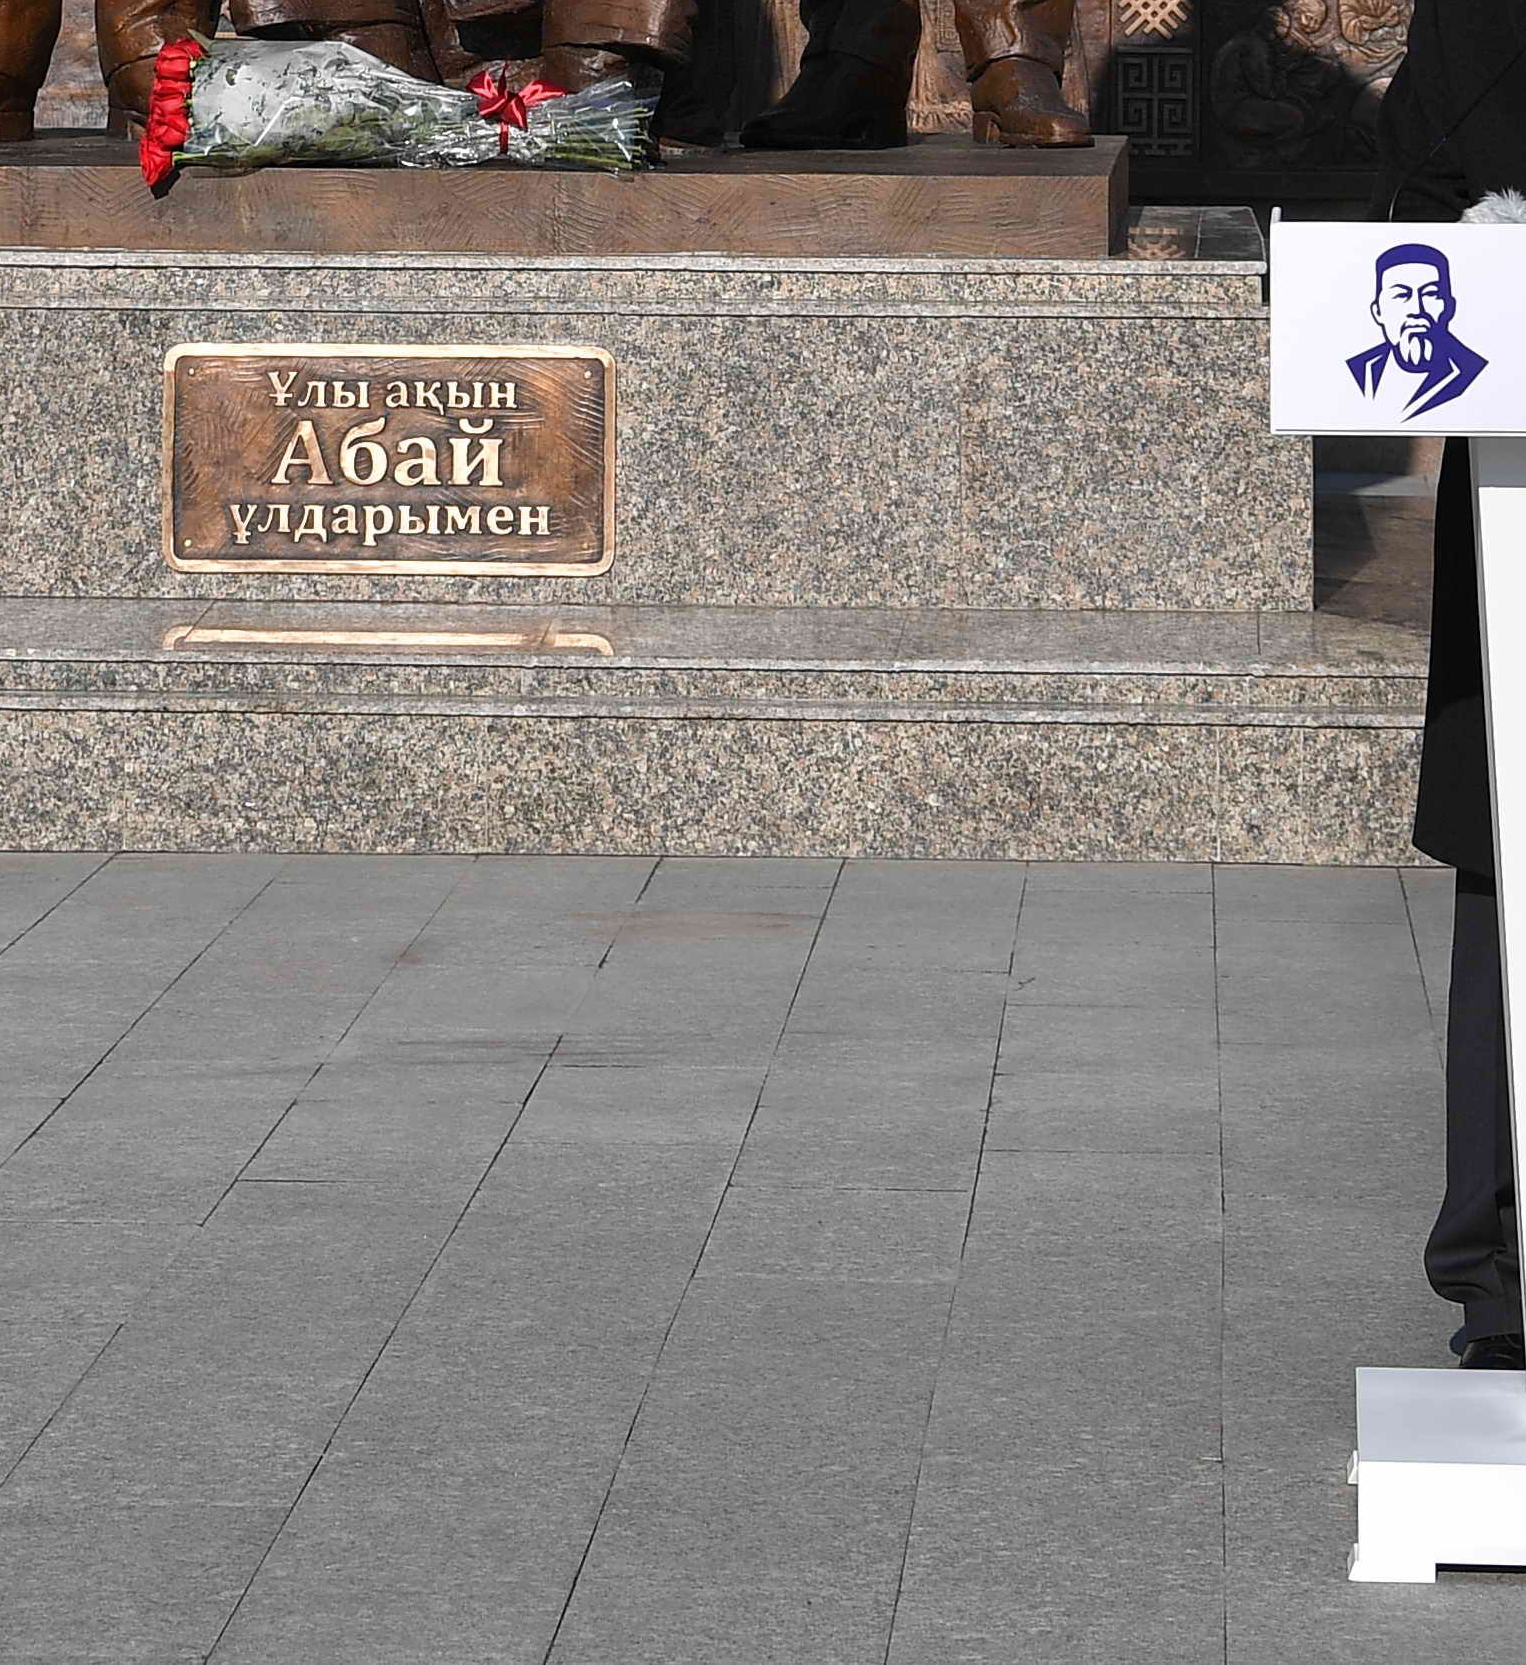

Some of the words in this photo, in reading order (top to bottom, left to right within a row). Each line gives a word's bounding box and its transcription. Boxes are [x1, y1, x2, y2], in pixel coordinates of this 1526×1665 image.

[268, 370, 370, 409] Ұлы
[385, 380, 518, 416] ақын
[270, 416, 504, 487] Абай
[229, 503, 551, 547] ұлдарымен
